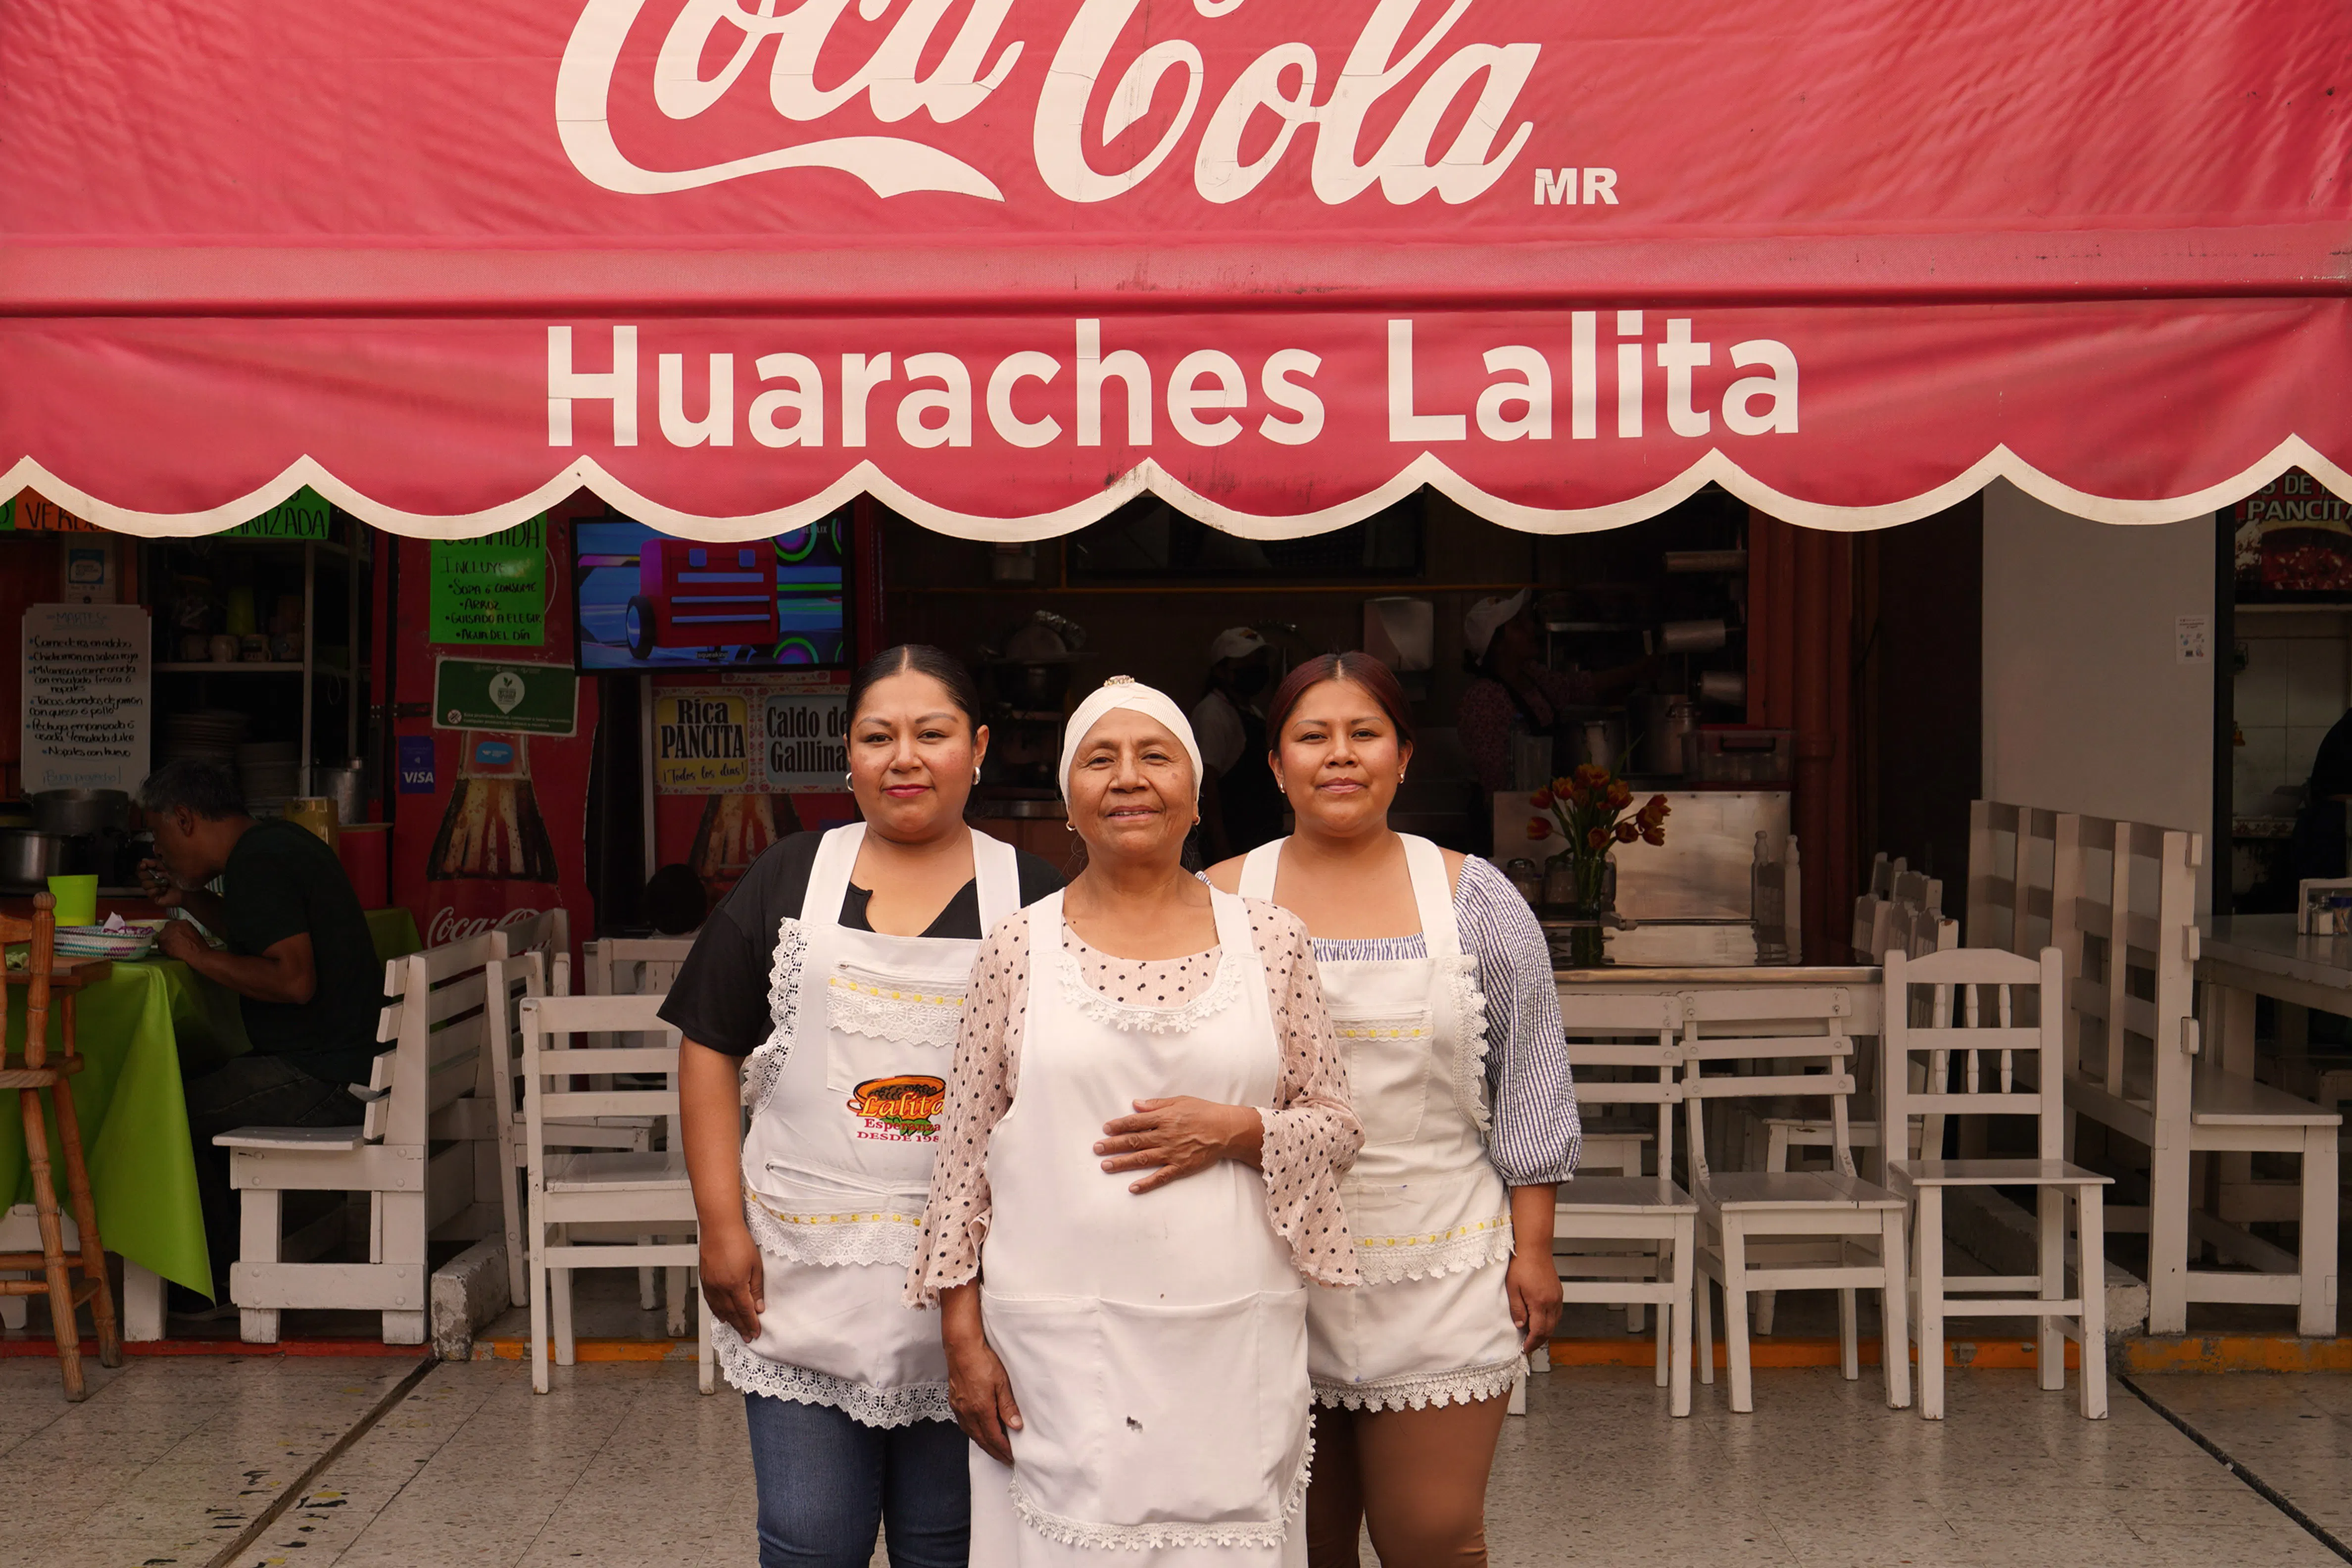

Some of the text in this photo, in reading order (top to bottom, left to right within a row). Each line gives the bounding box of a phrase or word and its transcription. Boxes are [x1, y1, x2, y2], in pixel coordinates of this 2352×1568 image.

[1534, 168, 1618, 204] MR
[548, 310, 1798, 448] Huaraches Lalita
[2285, 474, 2312, 495] DE
[464, 597, 501, 610] ARROZ
[451, 612, 494, 624] GUISADO
[497, 614, 504, 623] A
[461, 629, 488, 640] AGUA
[490, 630, 509, 640] DEL
[677, 698, 729, 724] Rica
[767, 706, 820, 738] Caldo
[661, 725, 746, 758] PANCITA
[48, 746, 86, 758] Nopales
[402, 771, 434, 784] VISA
[701, 765, 715, 779] los
[864, 1118, 940, 1132] Esperanza
[857, 1131, 911, 1142] DESDE
